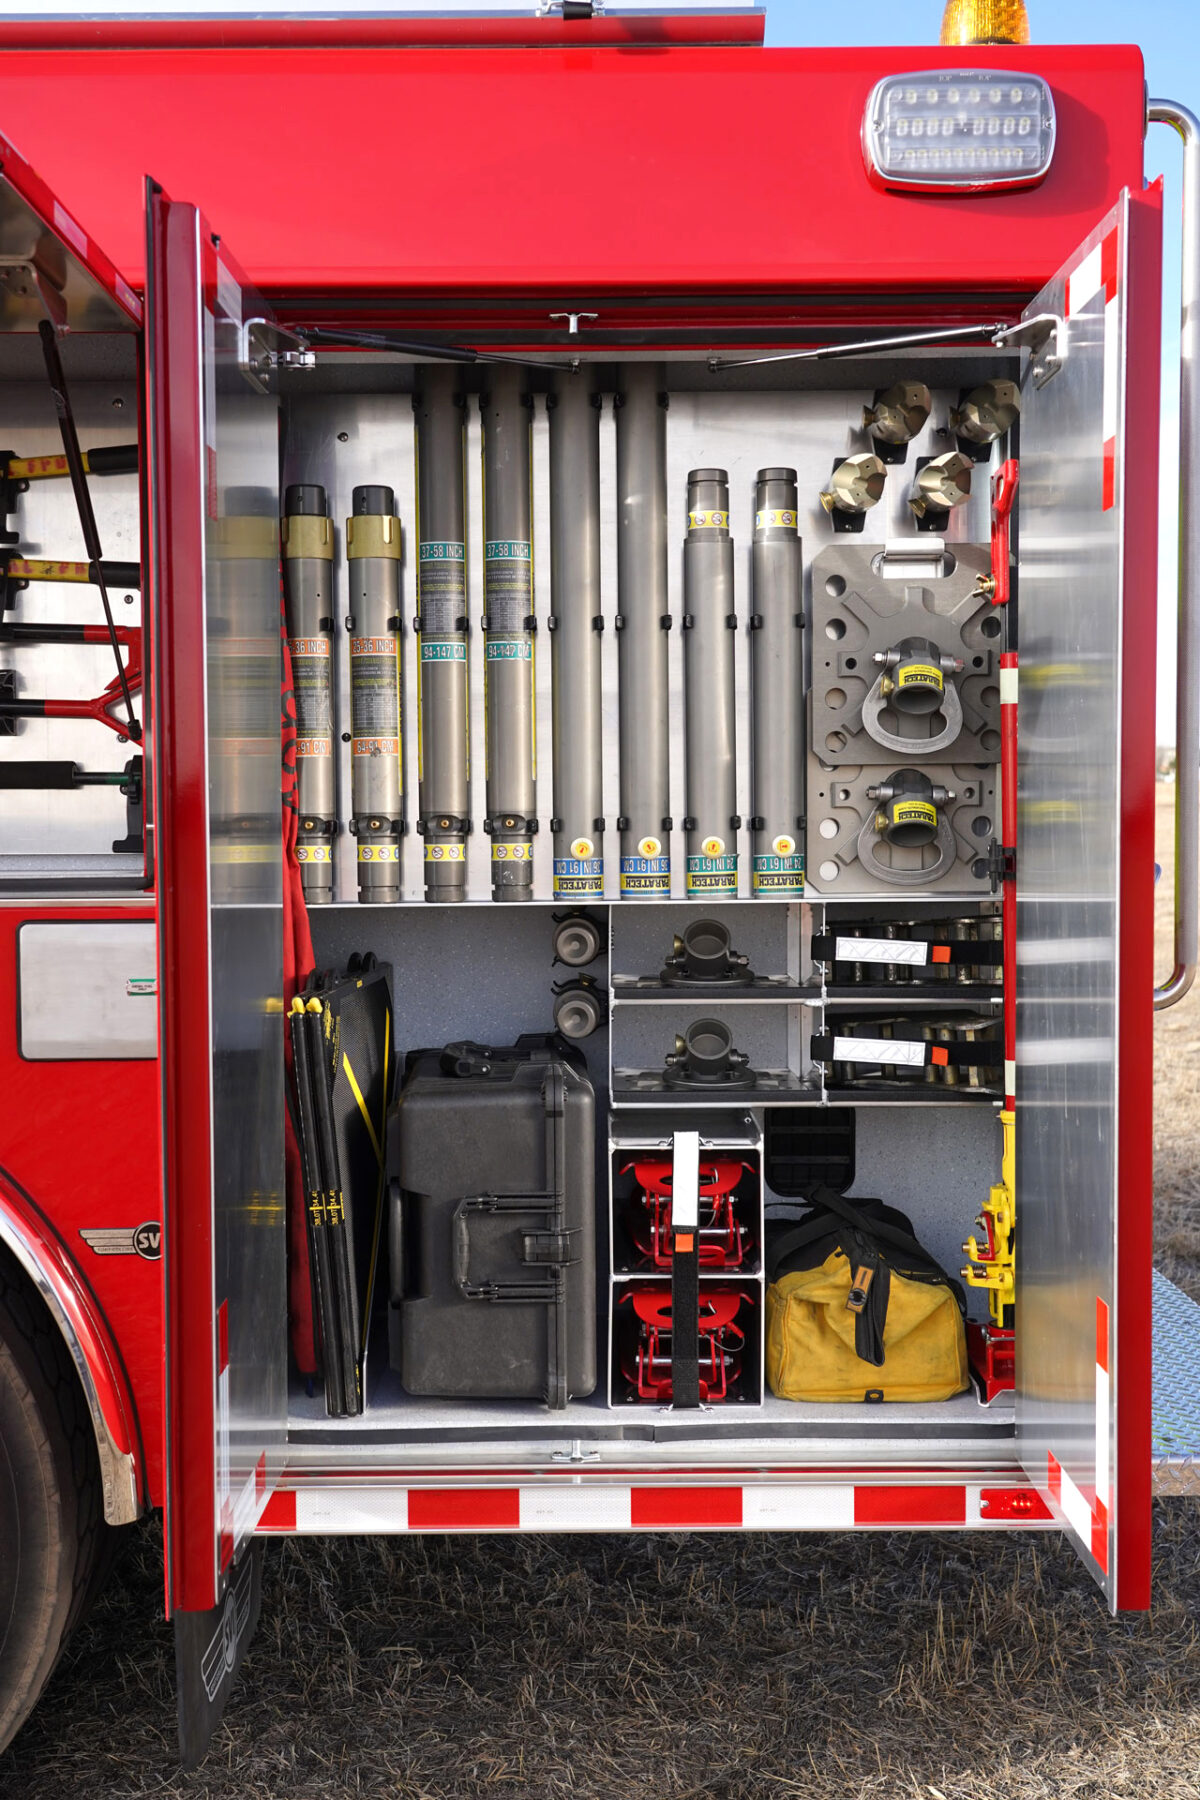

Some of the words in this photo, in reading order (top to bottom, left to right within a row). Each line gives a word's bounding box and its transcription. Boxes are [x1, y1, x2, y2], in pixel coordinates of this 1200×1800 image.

[421, 545, 444, 558] 37-58
[446, 544, 463, 558] INCH
[487, 544, 509, 557] 37-58
[511, 543, 529, 557] INCH
[289, 641, 306, 653] 5-36
[307, 641, 326, 653] INCH
[353, 640, 373, 653] 25-36
[376, 640, 394, 652] INCH
[424, 646, 451, 658] 94-147
[453, 646, 464, 658] CM
[489, 645, 516, 657] 94-147
[357, 741, 379, 753] 64-91
[381, 741, 394, 752] CM
[569, 861, 578, 873] 91
[637, 860, 646, 872] 91
[651, 860, 659, 871] IN
[702, 858, 712, 870] 61
[716, 858, 725, 870] IN
[769, 858, 779, 870] 61
[558, 880, 602, 890] PARATECH
[625, 878, 669, 888] PARATECH
[692, 877, 736, 887] PARATECH
[759, 876, 802, 887] PARATECH
[138, 1232, 161, 1249] SV
